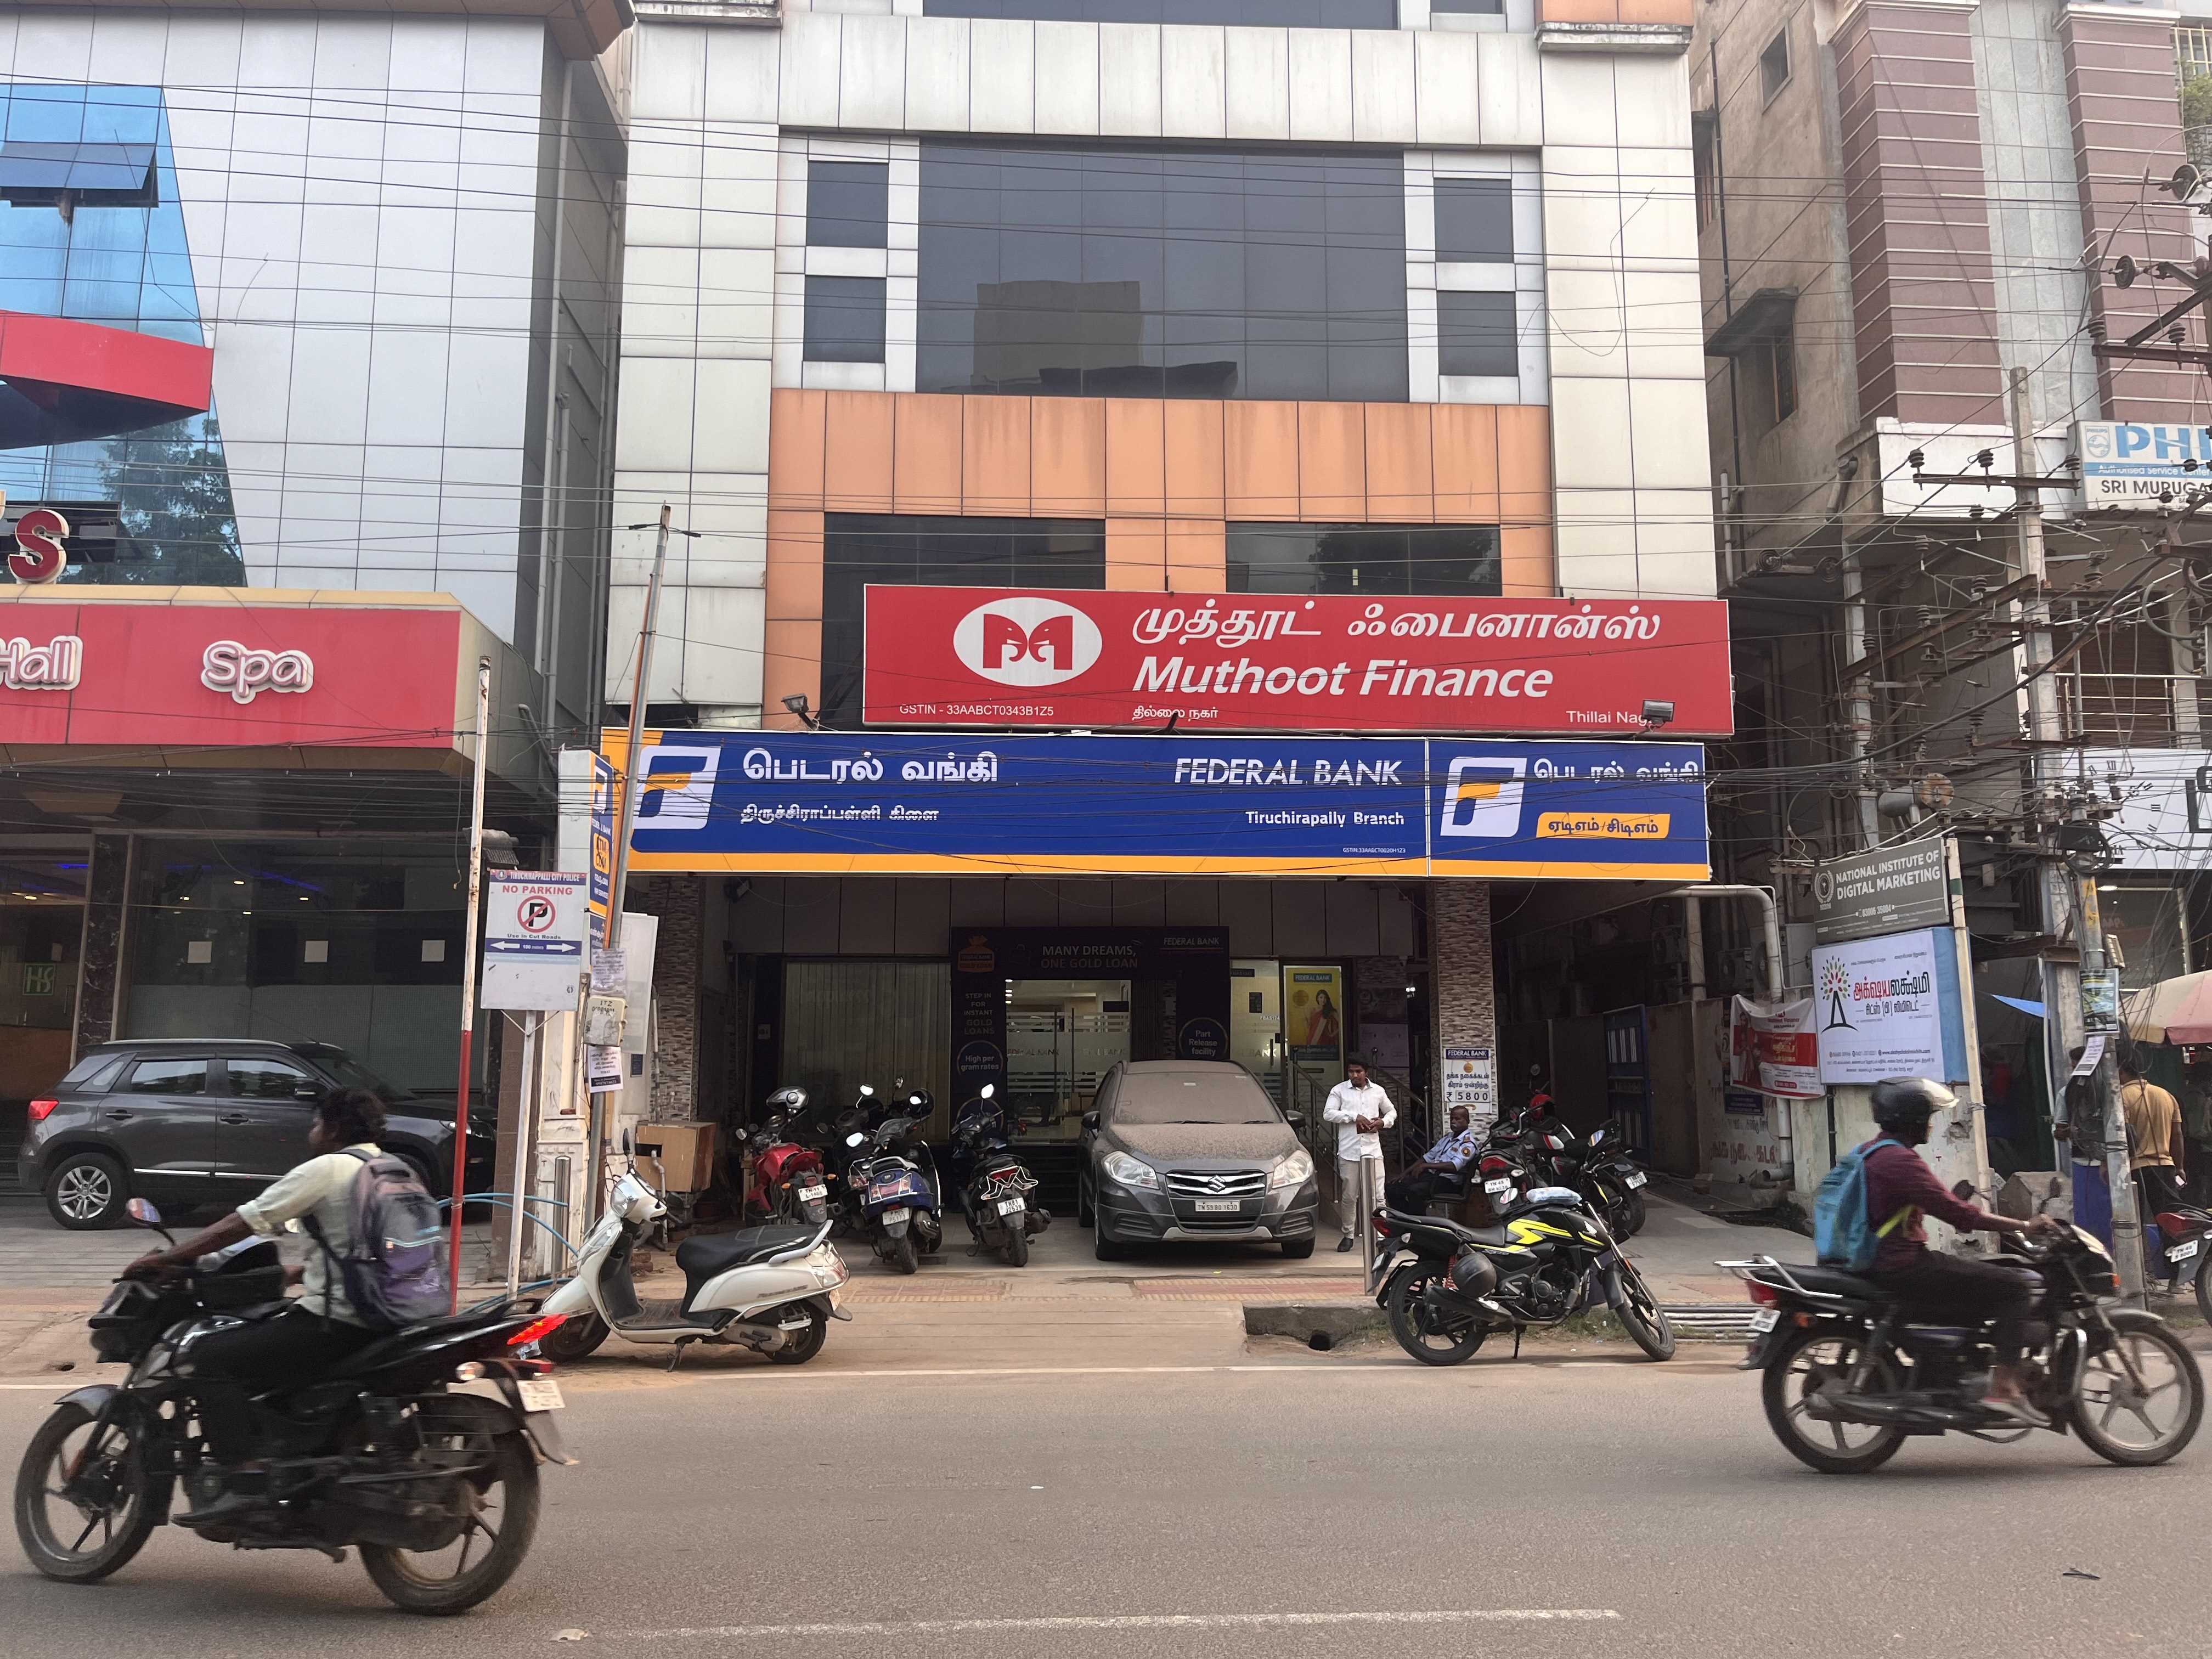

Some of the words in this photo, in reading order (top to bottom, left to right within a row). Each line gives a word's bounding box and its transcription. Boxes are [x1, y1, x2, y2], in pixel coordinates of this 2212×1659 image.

[2098, 465, 2145, 475] Authorised
[2148, 466, 2177, 475] Service
[2102, 480, 2126, 493] SRI
[1132, 599, 1321, 648] முத்தூட்
[1348, 603, 1660, 640] ஃபைனான்ஸ்
[205, 644, 308, 698] Spa
[1132, 656, 1351, 696] Muthoot
[1359, 659, 1553, 698] Finance
[899, 704, 936, 714] GSTIN
[946, 705, 1054, 716] 33AABCT0343B1Z5
[1132, 705, 1185, 721] தில்லை
[1188, 707, 1218, 722] நகர்
[1566, 710, 1611, 723] Thillai
[1616, 712, 1652, 726] Nag
[743, 748, 883, 784] பெடரல்
[902, 751, 997, 781] வங்கி
[1174, 758, 1304, 785] FEDERAL
[1313, 759, 1402, 786] BANK
[889, 805, 939, 820] கிளை
[1245, 811, 1345, 827] Tiruchirapally
[1353, 812, 1404, 825] Branch
[1836, 867, 1877, 883] NATIONAL
[1879, 853, 1924, 873] INSTITUTE
[1926, 849, 1939, 862] OF
[1837, 881, 1875, 900] DIGITAL
[1876, 866, 1940, 891] MARKETING
[503, 885, 518, 893] NO
[522, 885, 573, 895] PARKING
[1163, 937, 1195, 946] FEDERAL
[1198, 937, 1220, 945] BANK
[1042, 945, 1080, 956] MANY
[1082, 945, 1137, 957] DREAMS,
[1041, 958, 1067, 968] ONE
[1070, 958, 1103, 969] GOLD
[1105, 958, 1138, 968] LOAN
[964, 1027, 995, 1035] LOANS
[1195, 1030, 1211, 1038] Part
[1188, 1039, 1217, 1047] Release
[1191, 1047, 1216, 1057] facility
[965, 1054, 981, 1064] High
[983, 1056, 994, 1065] per
[961, 1064, 979, 1073] gram
[980, 1063, 999, 1071] rates
[1458, 1092, 1488, 1101] 5800
